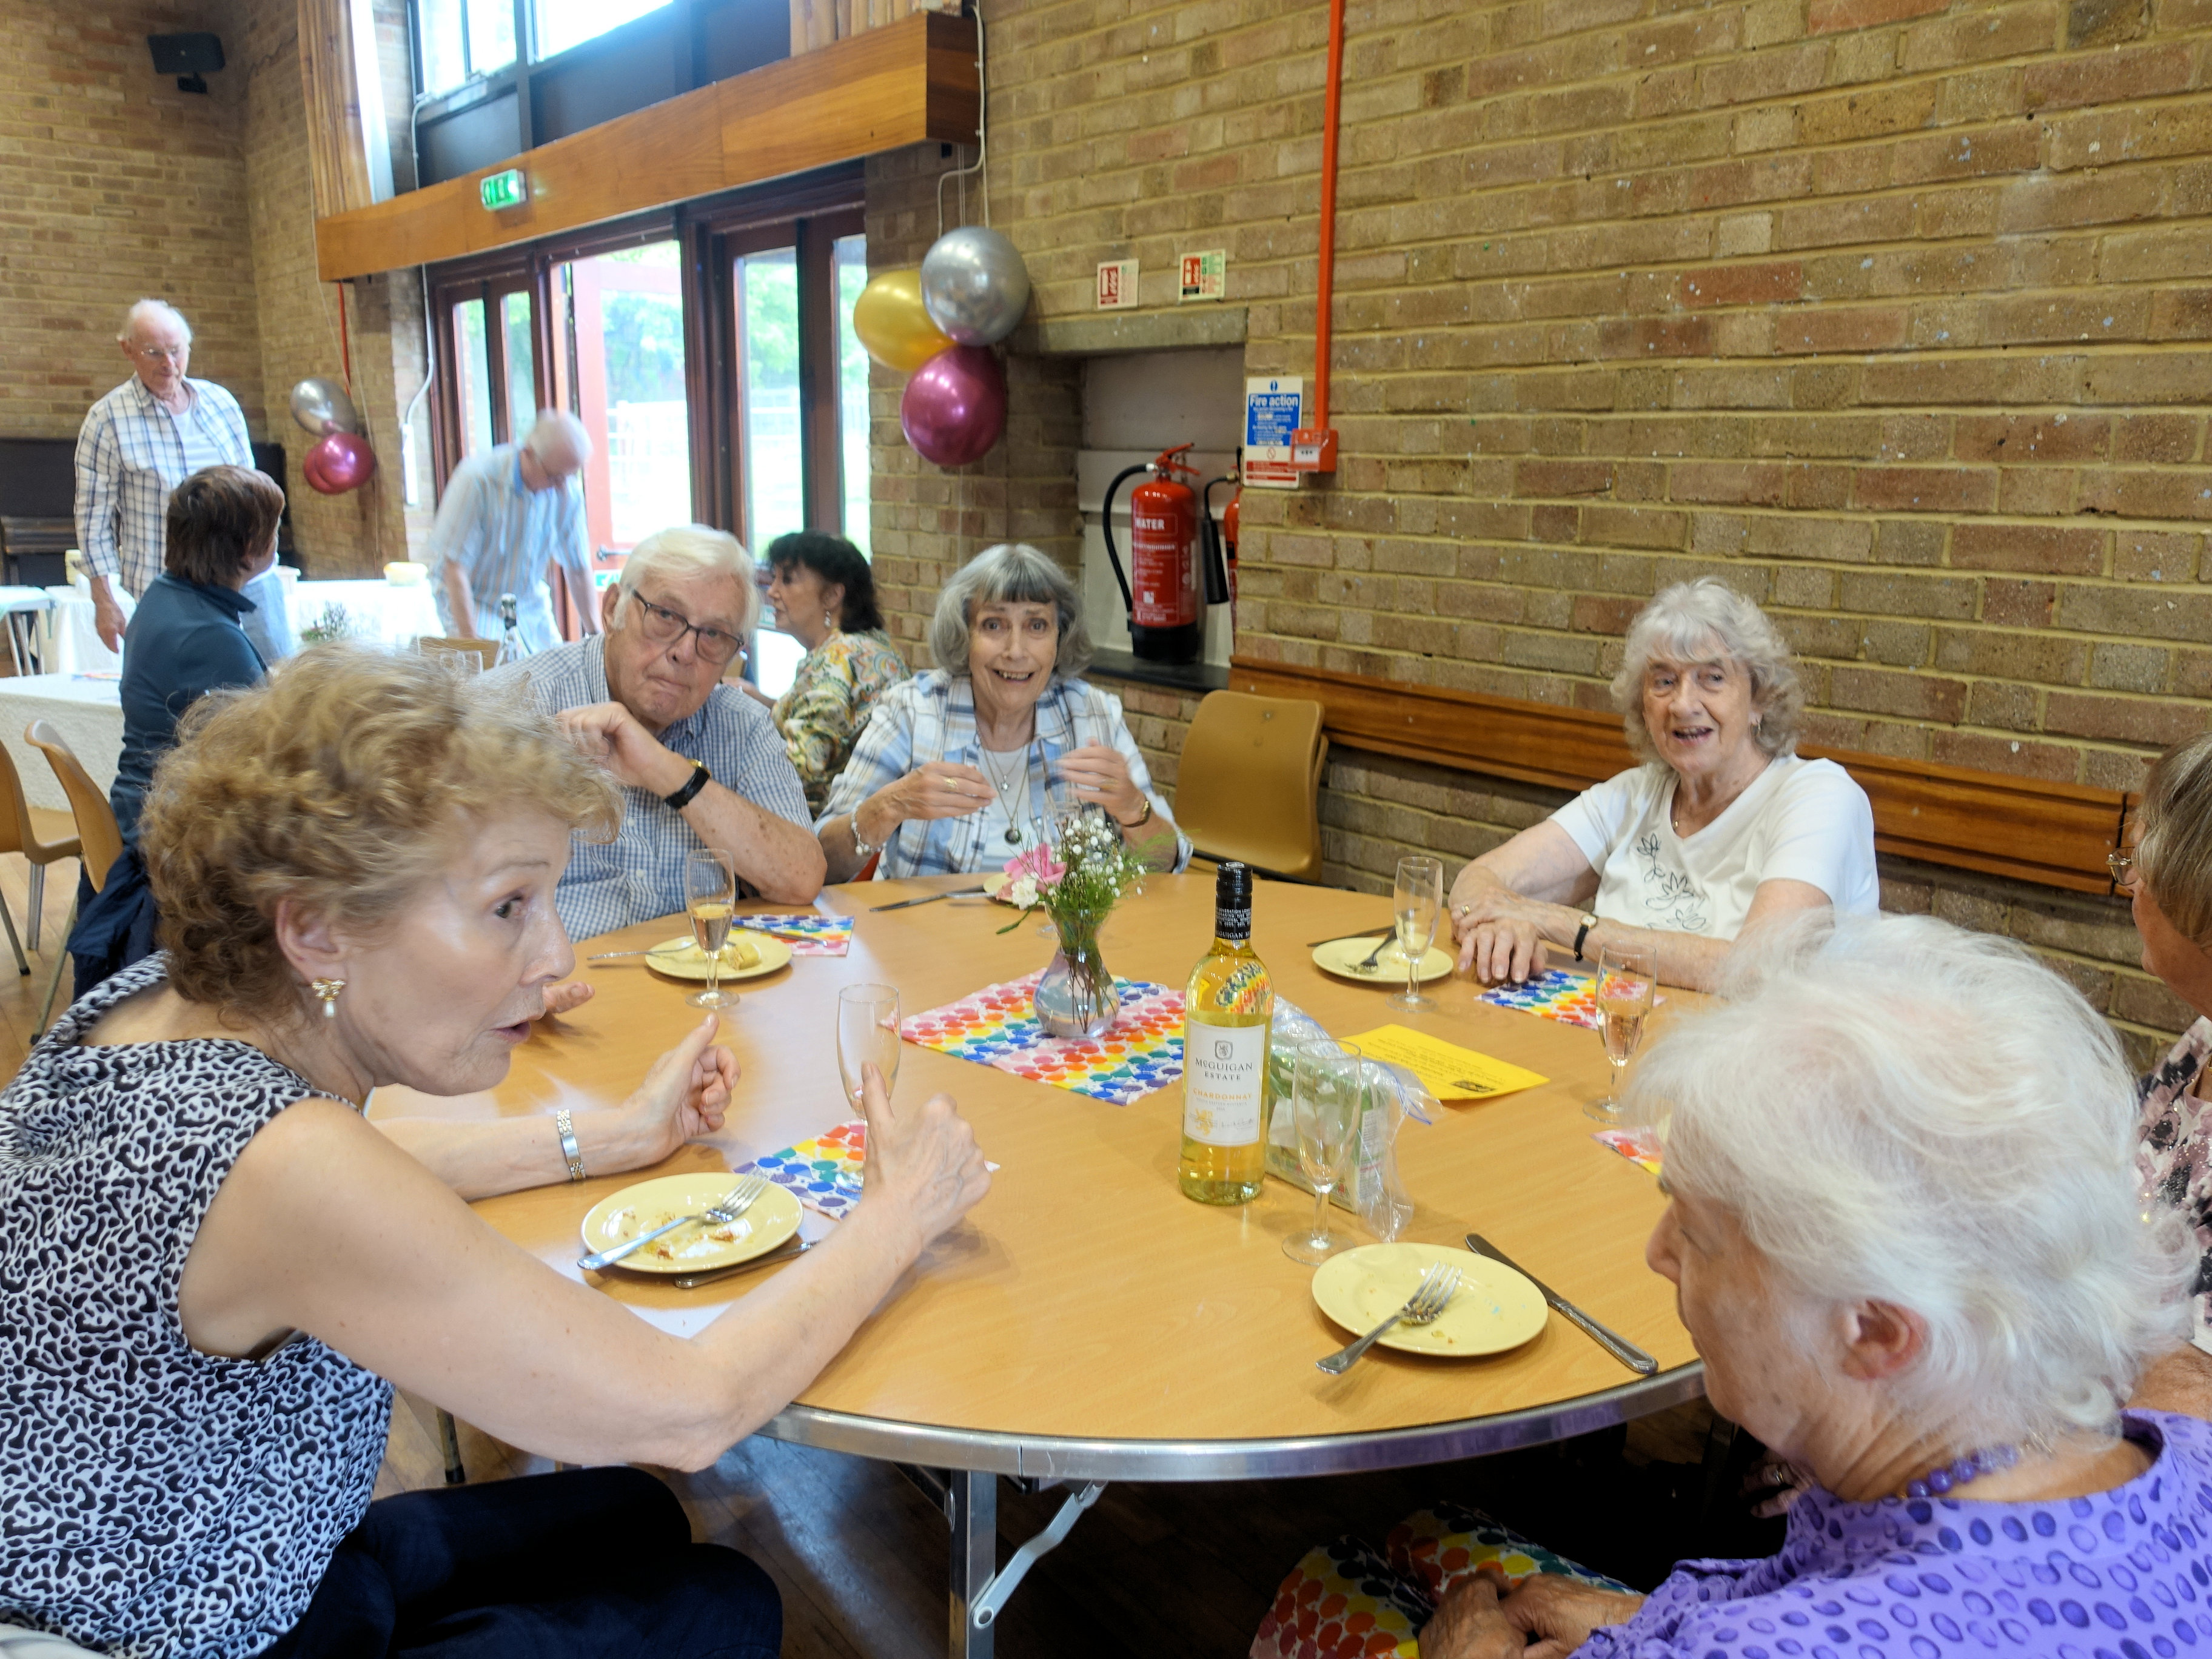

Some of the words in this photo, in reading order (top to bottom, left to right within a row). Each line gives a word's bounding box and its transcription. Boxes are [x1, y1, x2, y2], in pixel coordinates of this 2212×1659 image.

[1250, 394, 1267, 407] Fire
[1269, 394, 1298, 407] action
[1136, 517, 1165, 531] WATER
[1205, 1071, 1241, 1082] ESTATE
[1193, 1088, 1252, 1101] CHARDONNAY
